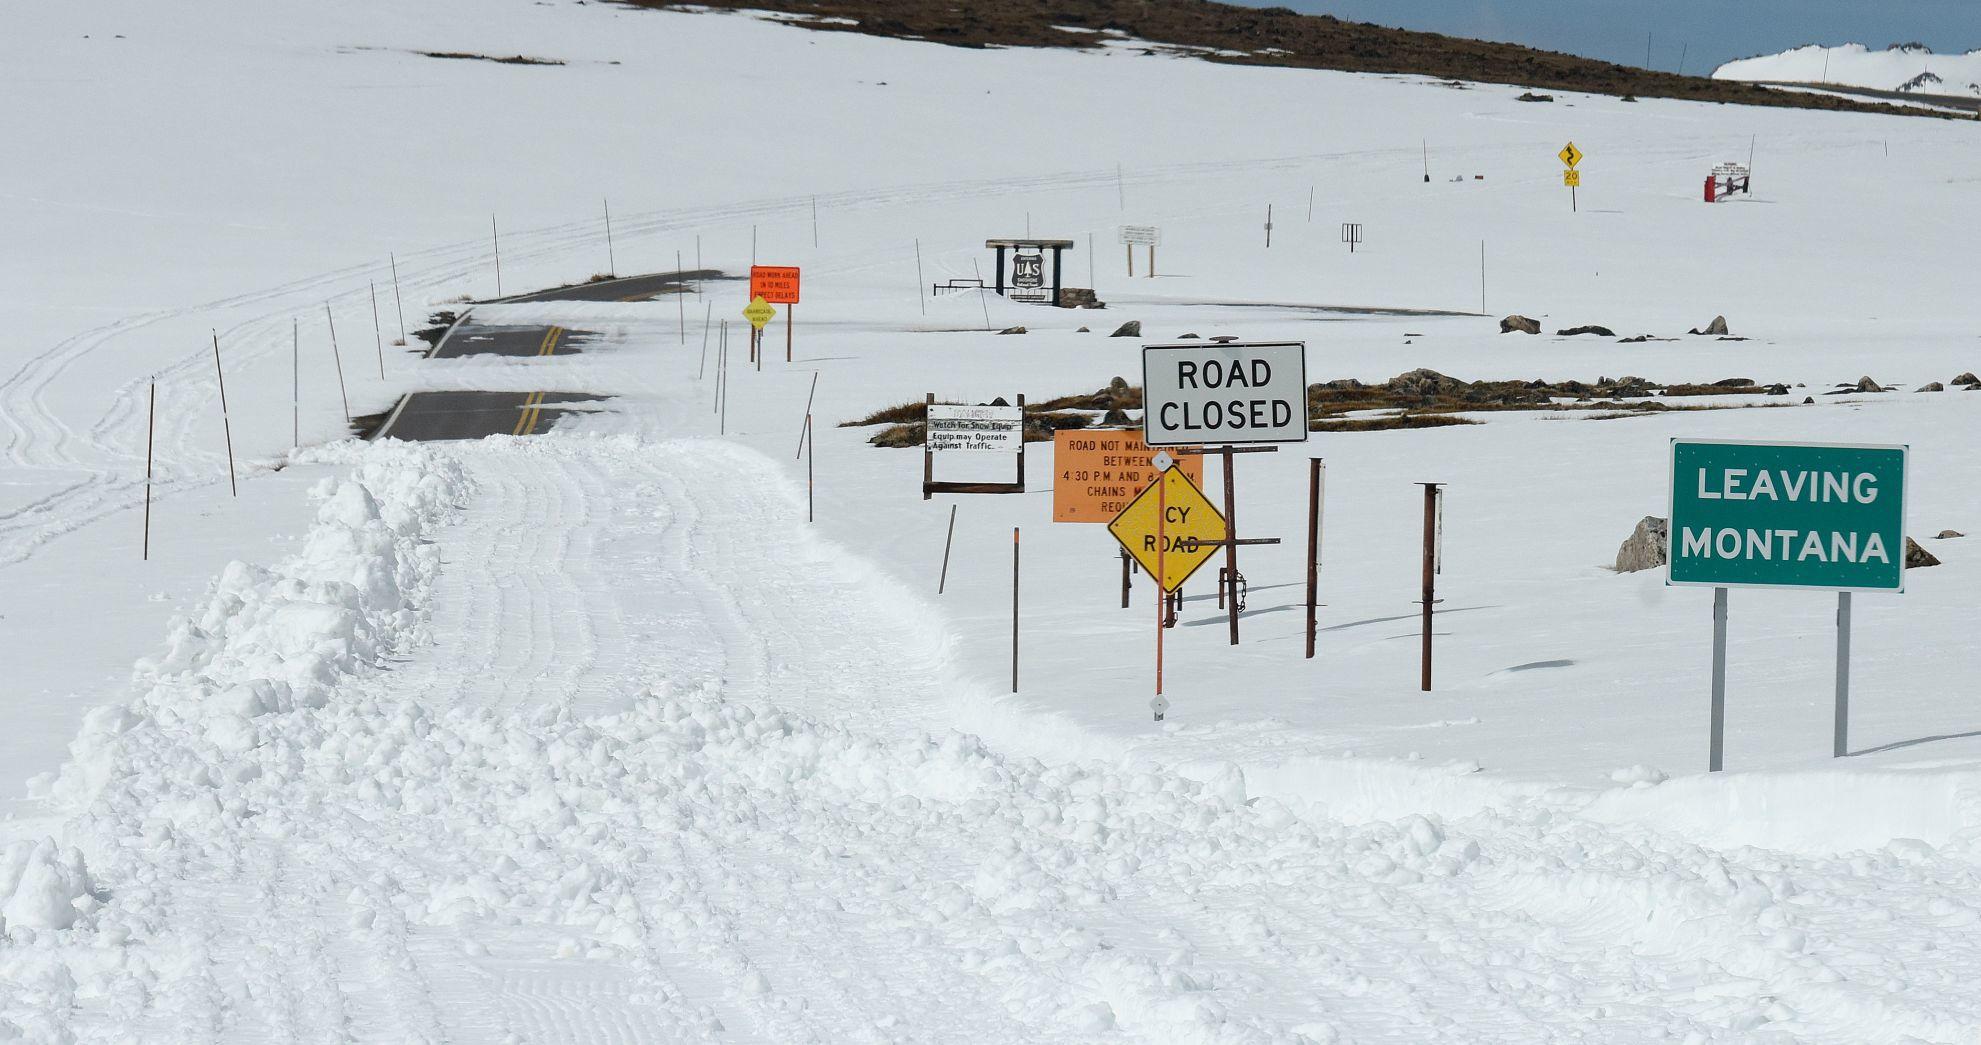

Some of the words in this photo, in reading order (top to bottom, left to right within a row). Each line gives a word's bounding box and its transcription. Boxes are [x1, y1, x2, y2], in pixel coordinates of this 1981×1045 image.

[1566, 172, 1578, 180] 20
[1178, 359, 1271, 389] ROAD
[1160, 400, 1292, 431] CLOSED
[970, 421, 989, 429] Snow
[956, 434, 972, 442] may
[975, 433, 1007, 441] Operate
[932, 442, 962, 450] Against
[1069, 440, 1096, 451] ROAD
[1100, 440, 1120, 451] NOT
[1103, 456, 1153, 466] BETWEEN
[1118, 471, 1140, 482] AND
[1698, 467, 1879, 504] LEAVING
[1087, 486, 1126, 497] CHAINS
[1165, 506, 1191, 524] CY
[1144, 534, 1199, 553] ROAD
[1681, 526, 1890, 564] MONTANA
